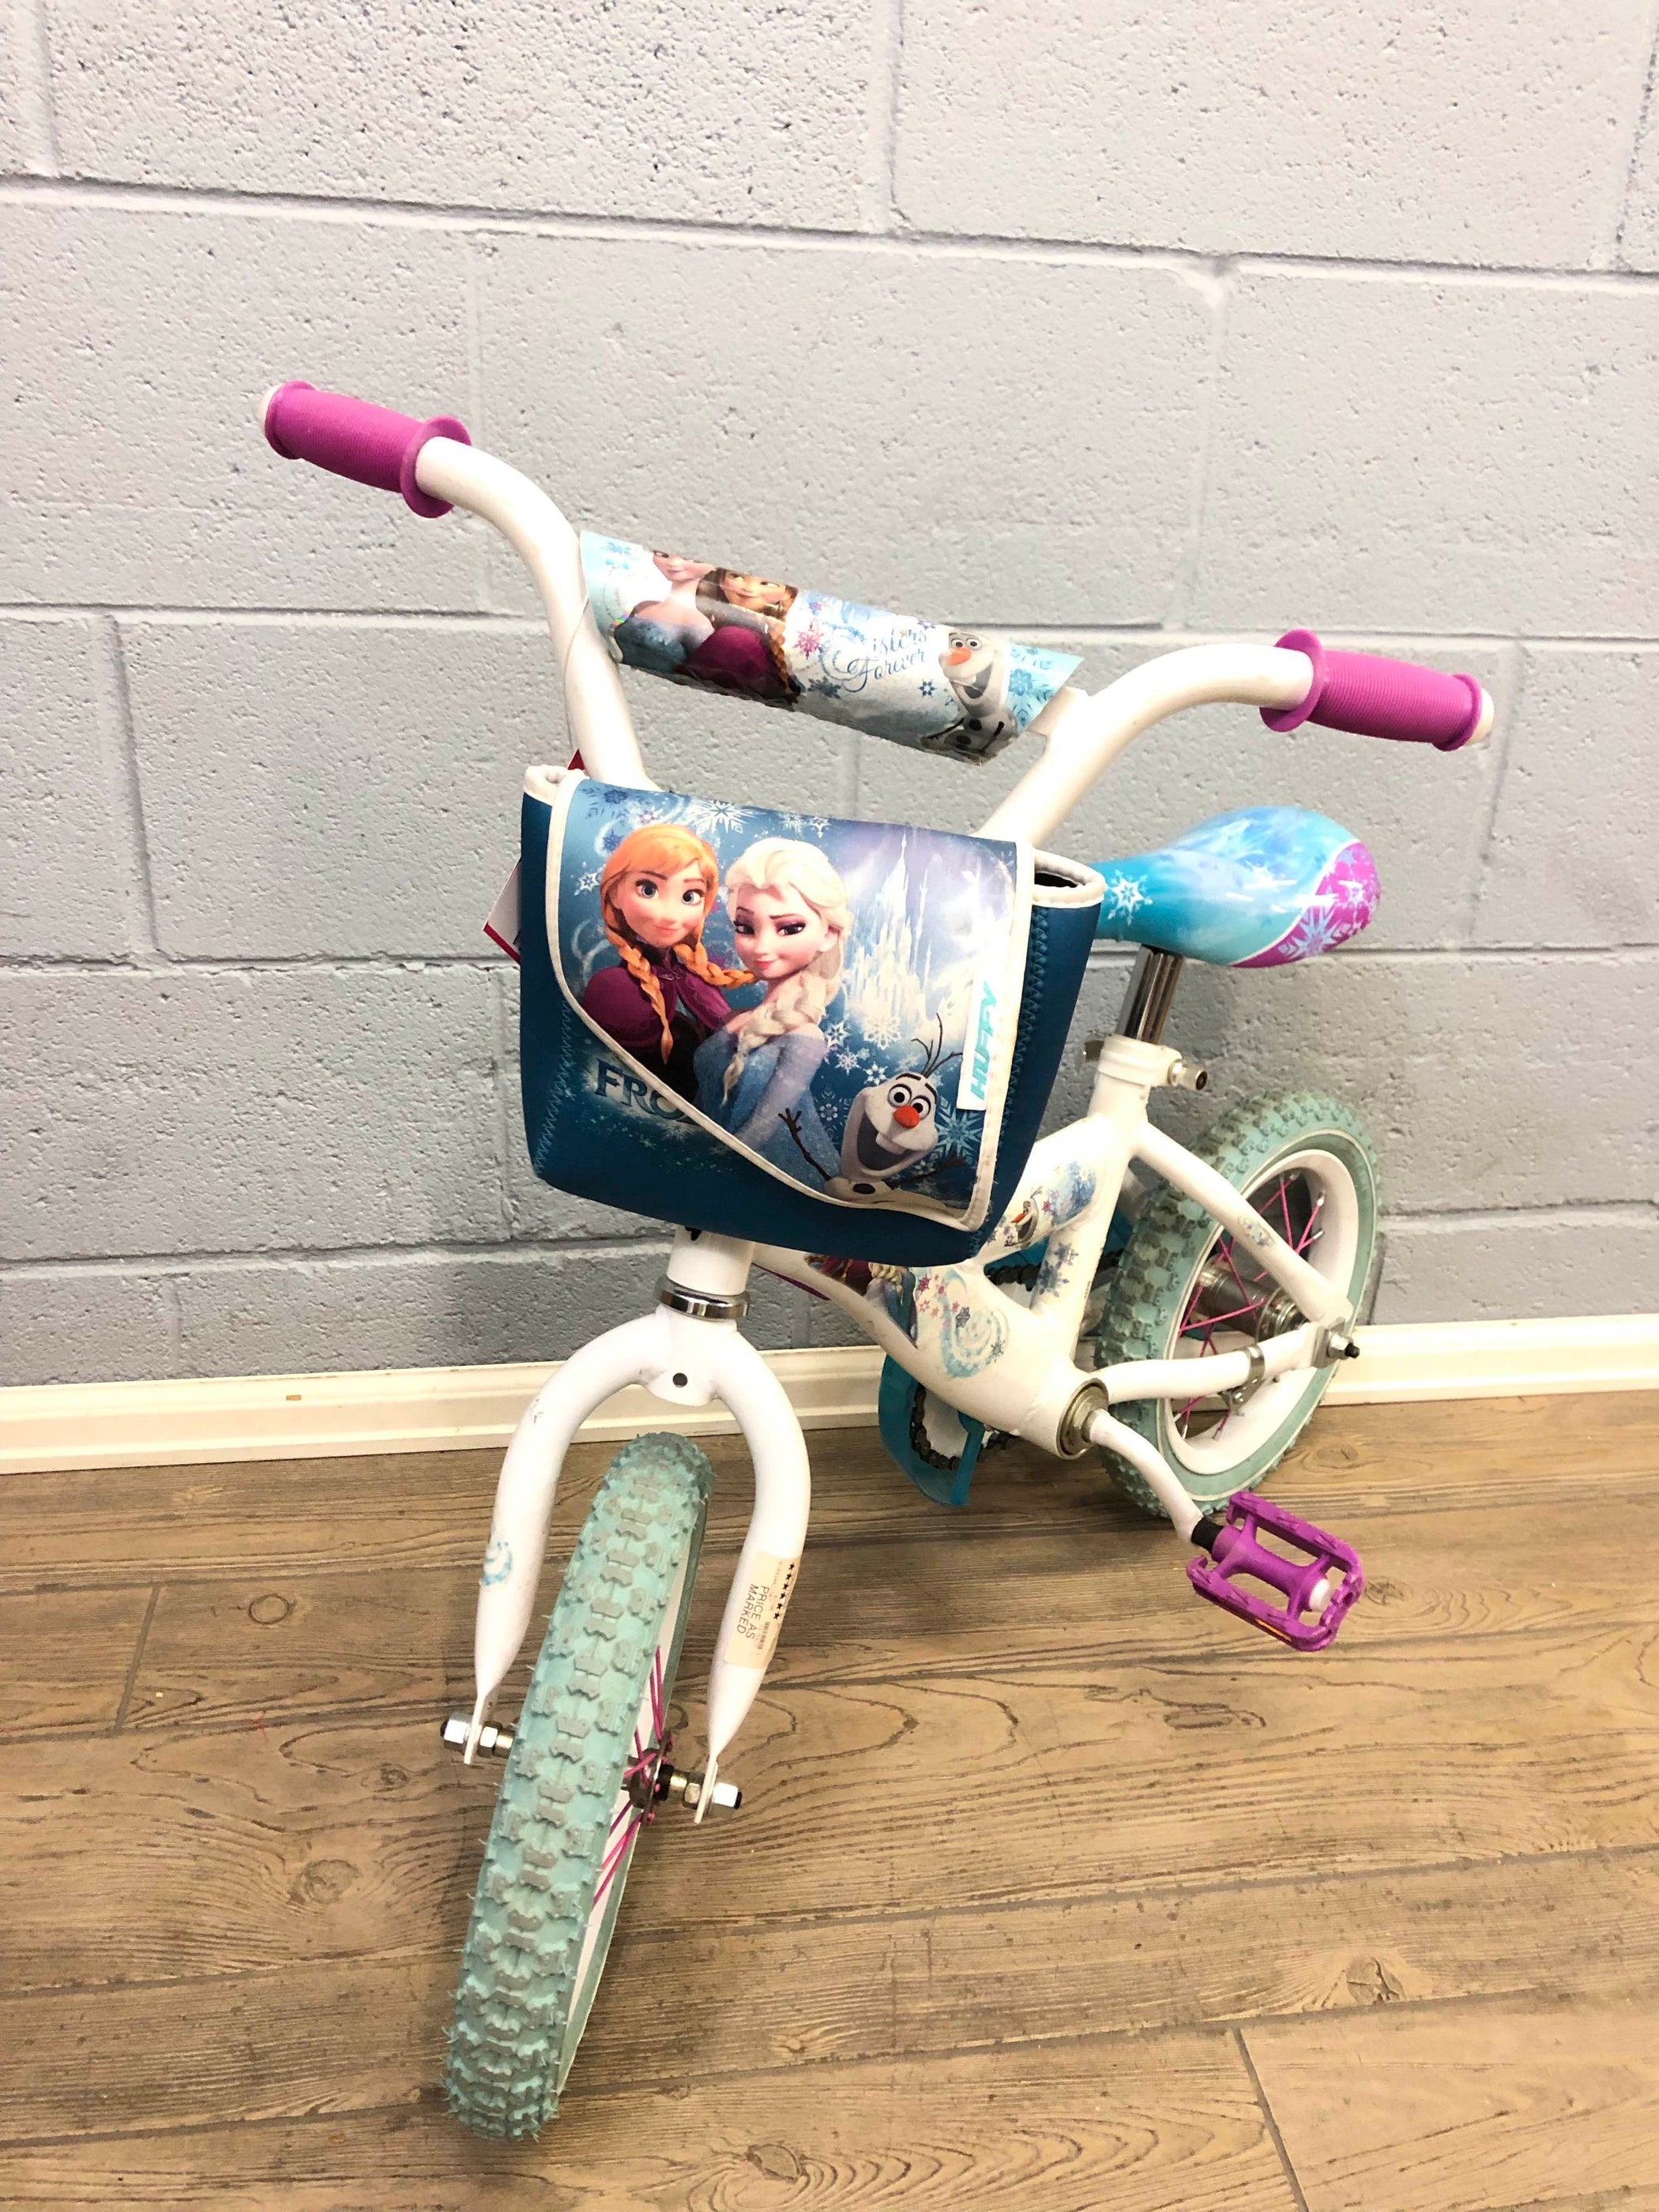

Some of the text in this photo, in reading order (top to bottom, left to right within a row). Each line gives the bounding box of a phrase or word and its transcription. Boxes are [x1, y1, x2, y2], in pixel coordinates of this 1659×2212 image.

[843, 649, 925, 693] Forever
[970, 980, 997, 1100] HUFFY
[595, 1058, 699, 1126] FRO
[736, 1583, 759, 1635] MARKED
[750, 1585, 769, 1621] PRICE
[746, 1623, 758, 1639] AS
